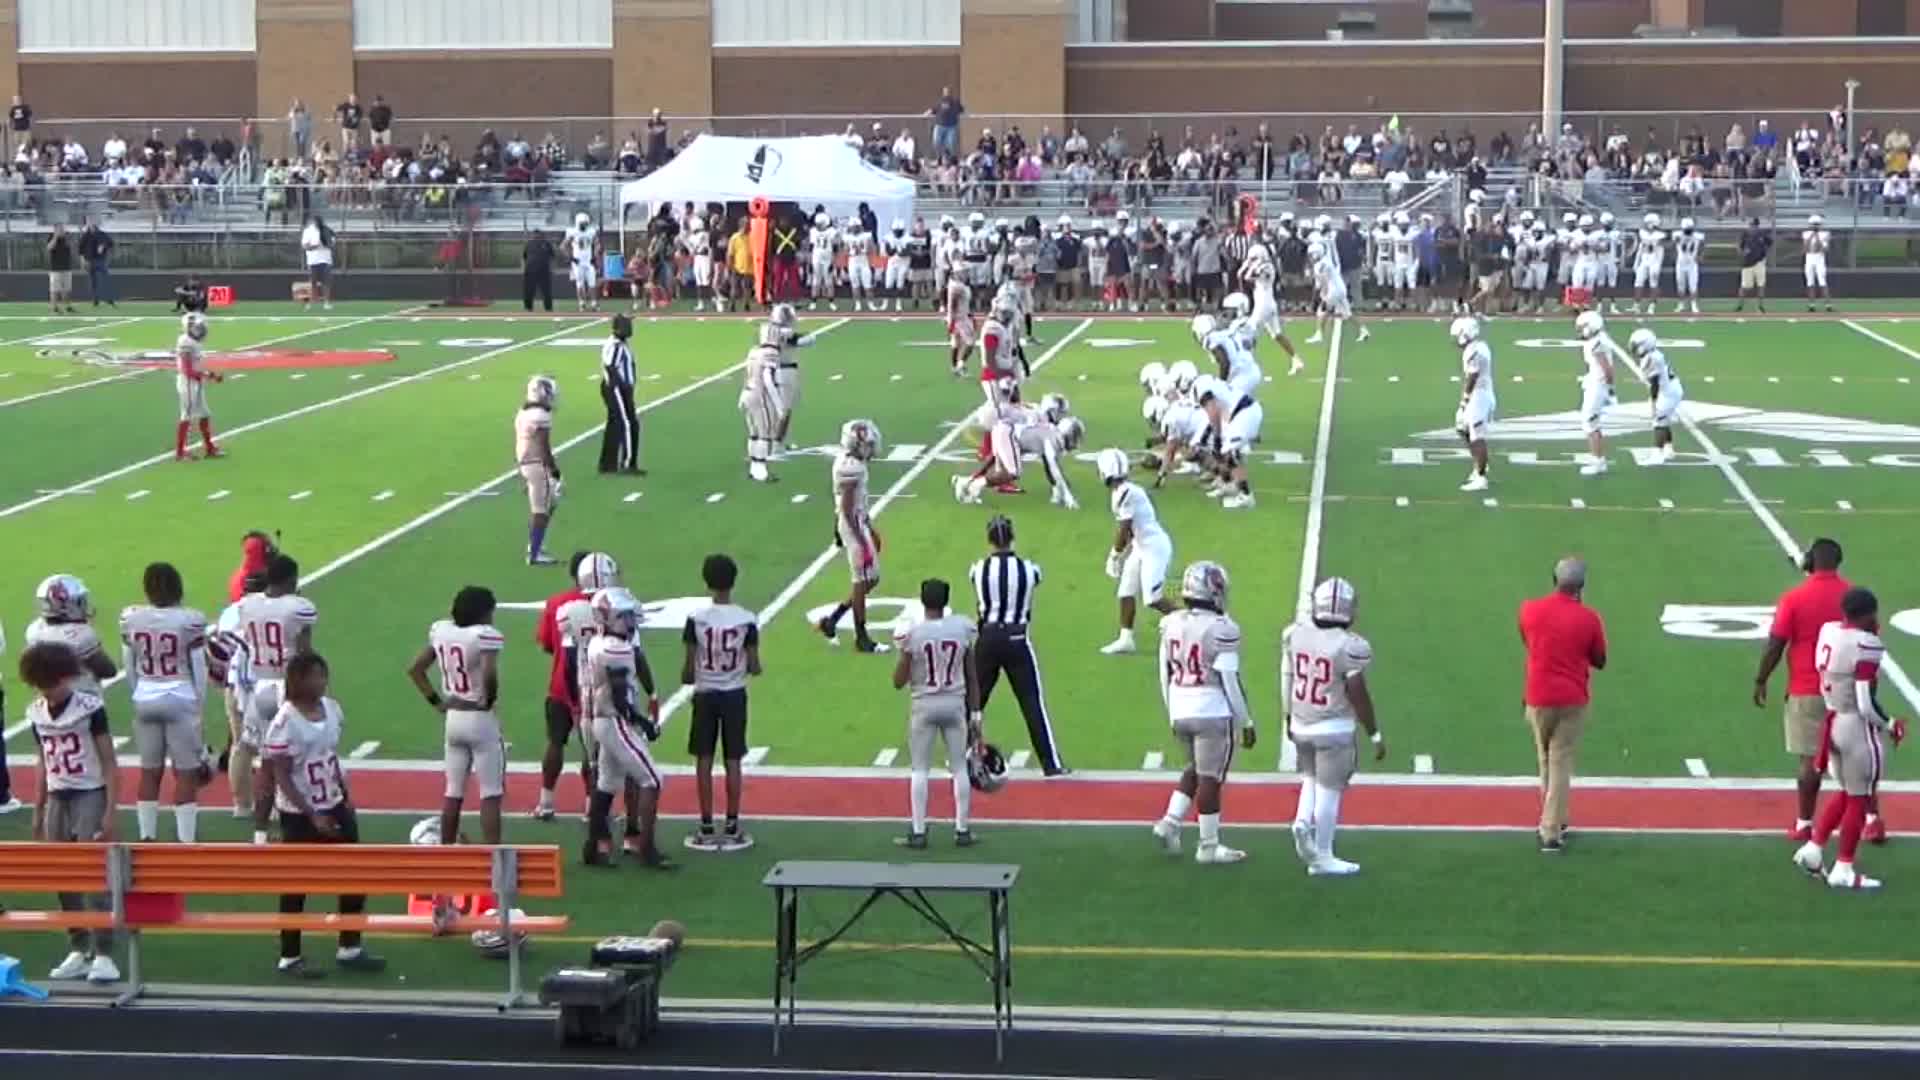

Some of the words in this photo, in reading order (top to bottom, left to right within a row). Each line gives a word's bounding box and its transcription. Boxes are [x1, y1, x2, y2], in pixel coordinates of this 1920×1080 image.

[134, 632, 179, 676] 32
[248, 621, 285, 668] 19
[438, 642, 471, 694] 13
[702, 627, 740, 672] 15
[923, 640, 960, 688] 17
[1295, 653, 1334, 706] 52
